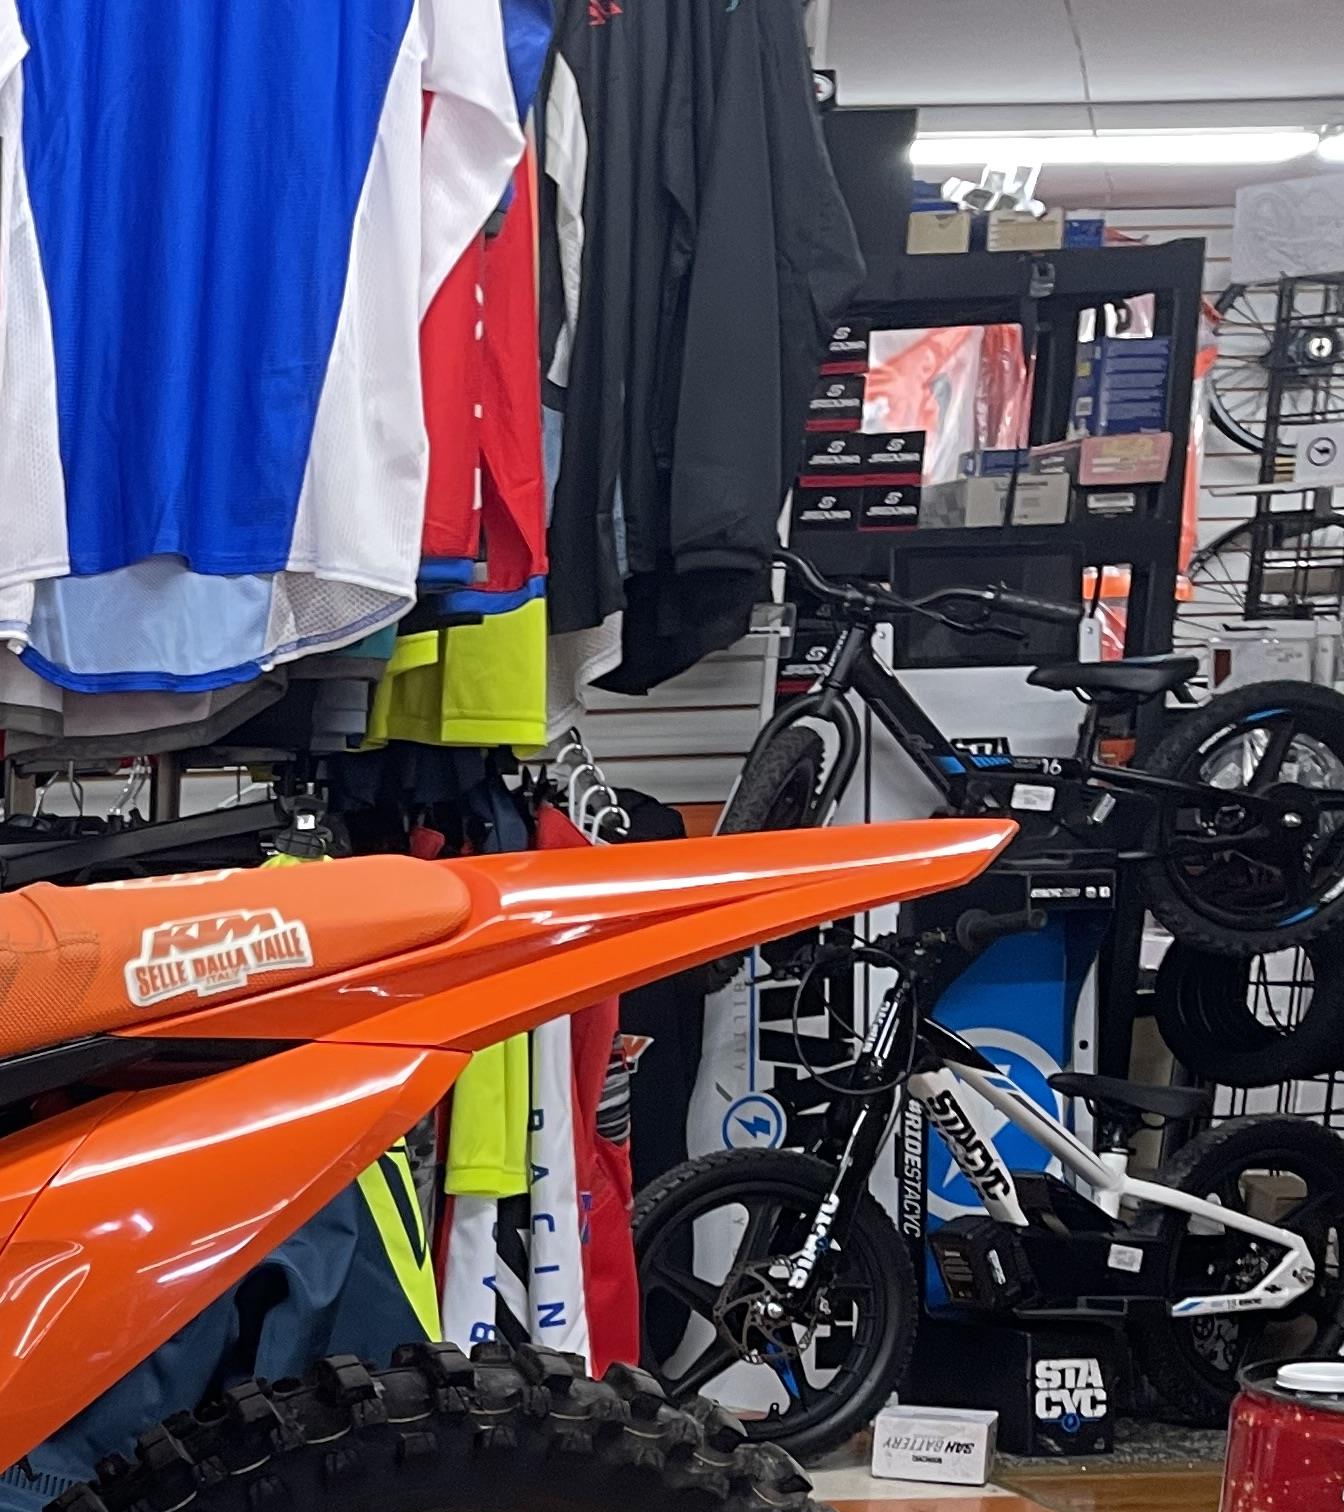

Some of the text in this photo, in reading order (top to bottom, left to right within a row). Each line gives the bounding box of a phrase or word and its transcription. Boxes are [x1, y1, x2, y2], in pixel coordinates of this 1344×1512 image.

[148, 910, 278, 960] KTM
[134, 926, 304, 998] SELLE DALLA VALLE
[927, 1089, 1012, 1202] STACYC
[1034, 1358, 1104, 1389] STA
[1034, 1388, 1108, 1420] CYC
[881, 1436, 946, 1453] BATTERY
